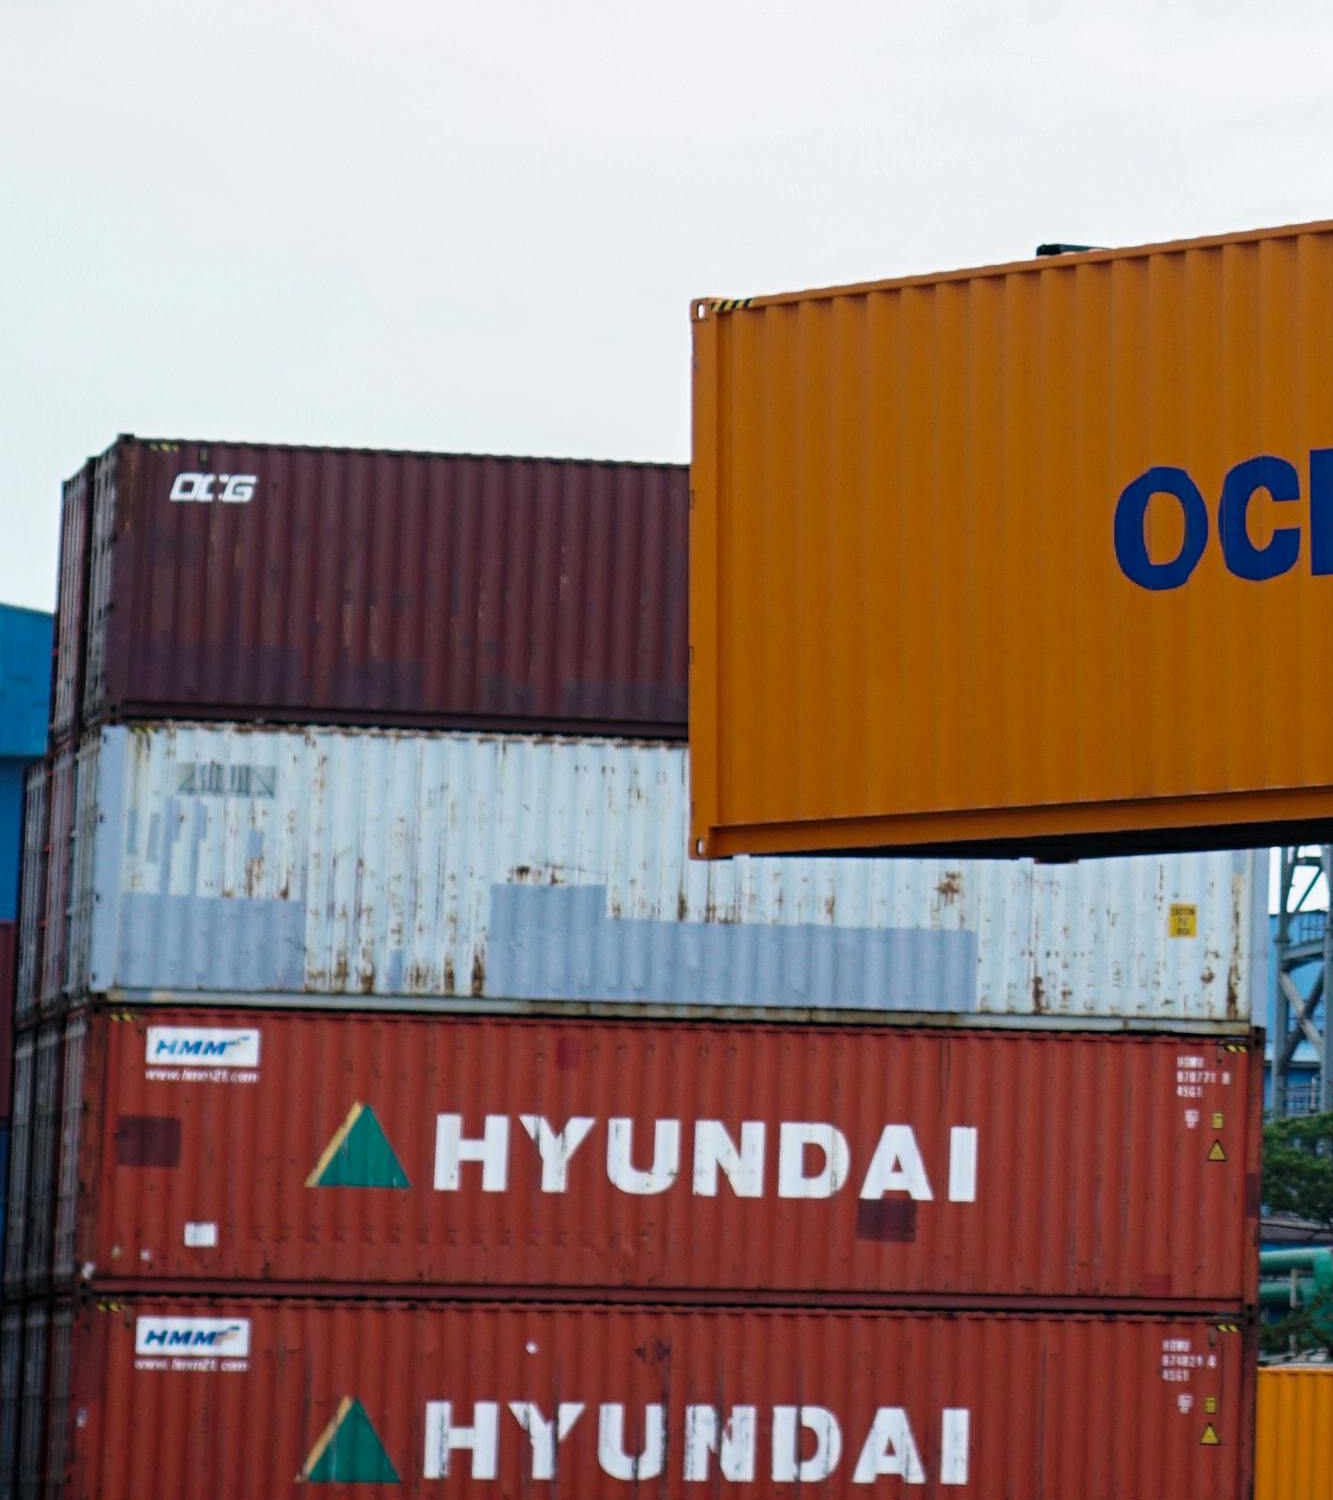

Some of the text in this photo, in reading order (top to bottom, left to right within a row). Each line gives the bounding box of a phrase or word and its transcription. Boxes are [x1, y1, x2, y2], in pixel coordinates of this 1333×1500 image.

[156, 1039, 228, 1057] HMM
[433, 1113, 978, 1203] HYUNDAI
[144, 1329, 218, 1347] HMM
[423, 1401, 970, 1485] HYUNDAI
